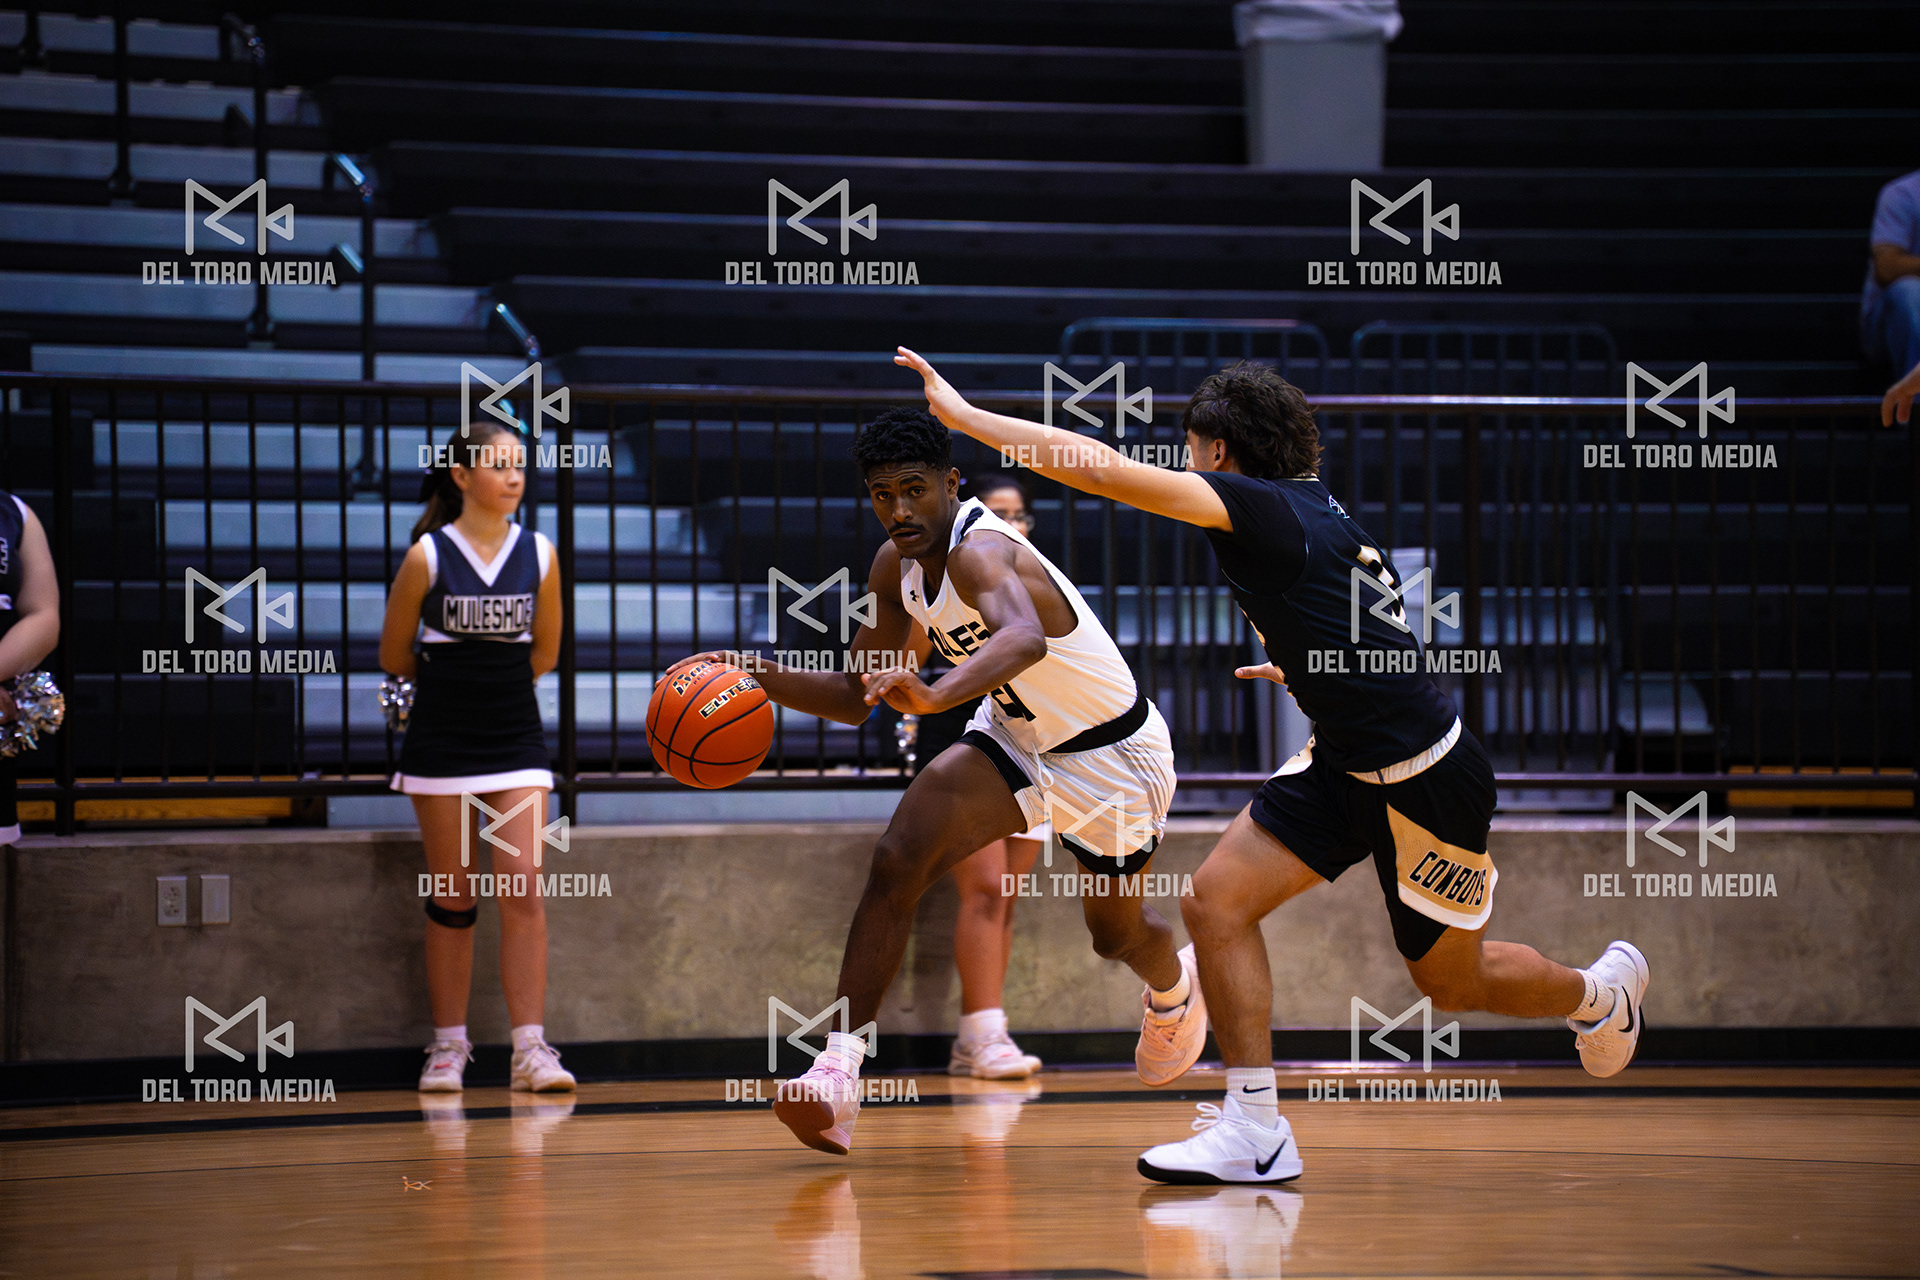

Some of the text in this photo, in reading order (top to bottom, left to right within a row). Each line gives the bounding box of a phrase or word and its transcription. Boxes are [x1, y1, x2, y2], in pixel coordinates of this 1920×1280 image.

[443, 593, 533, 634] MULESHOE
[698, 681, 749, 719] ELITE
[1408, 850, 1487, 907] COWBOYS
